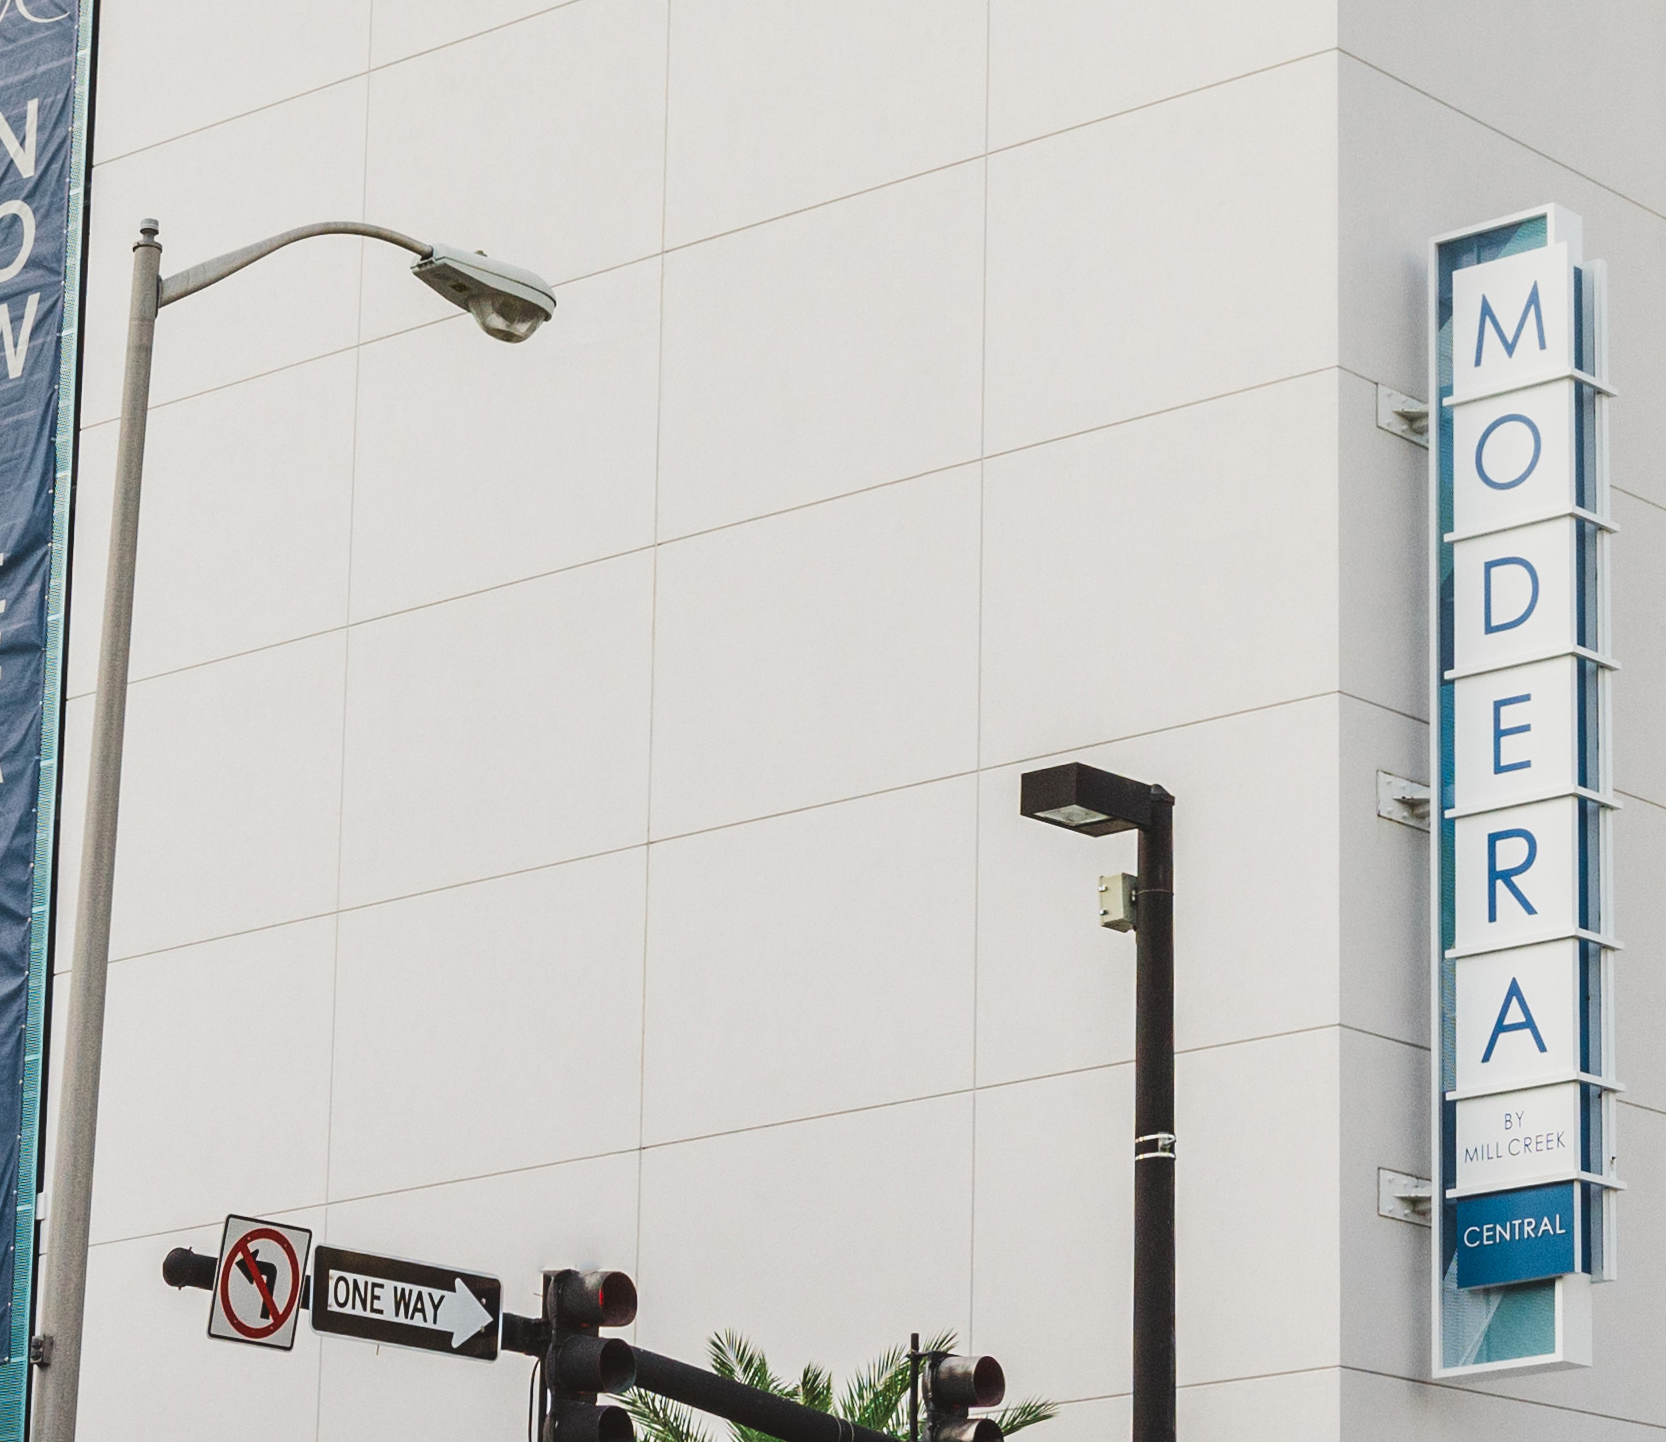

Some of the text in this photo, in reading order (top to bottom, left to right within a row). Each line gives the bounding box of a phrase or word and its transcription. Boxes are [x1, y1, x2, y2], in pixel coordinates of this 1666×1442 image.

[1474, 280, 1547, 1064] MODERA
[1504, 1110, 1525, 1130] BY
[1464, 1130, 1566, 1163] MILL CREEK
[1463, 1214, 1566, 1248] CENTRAL
[333, 1275, 446, 1325] ONE WAY
